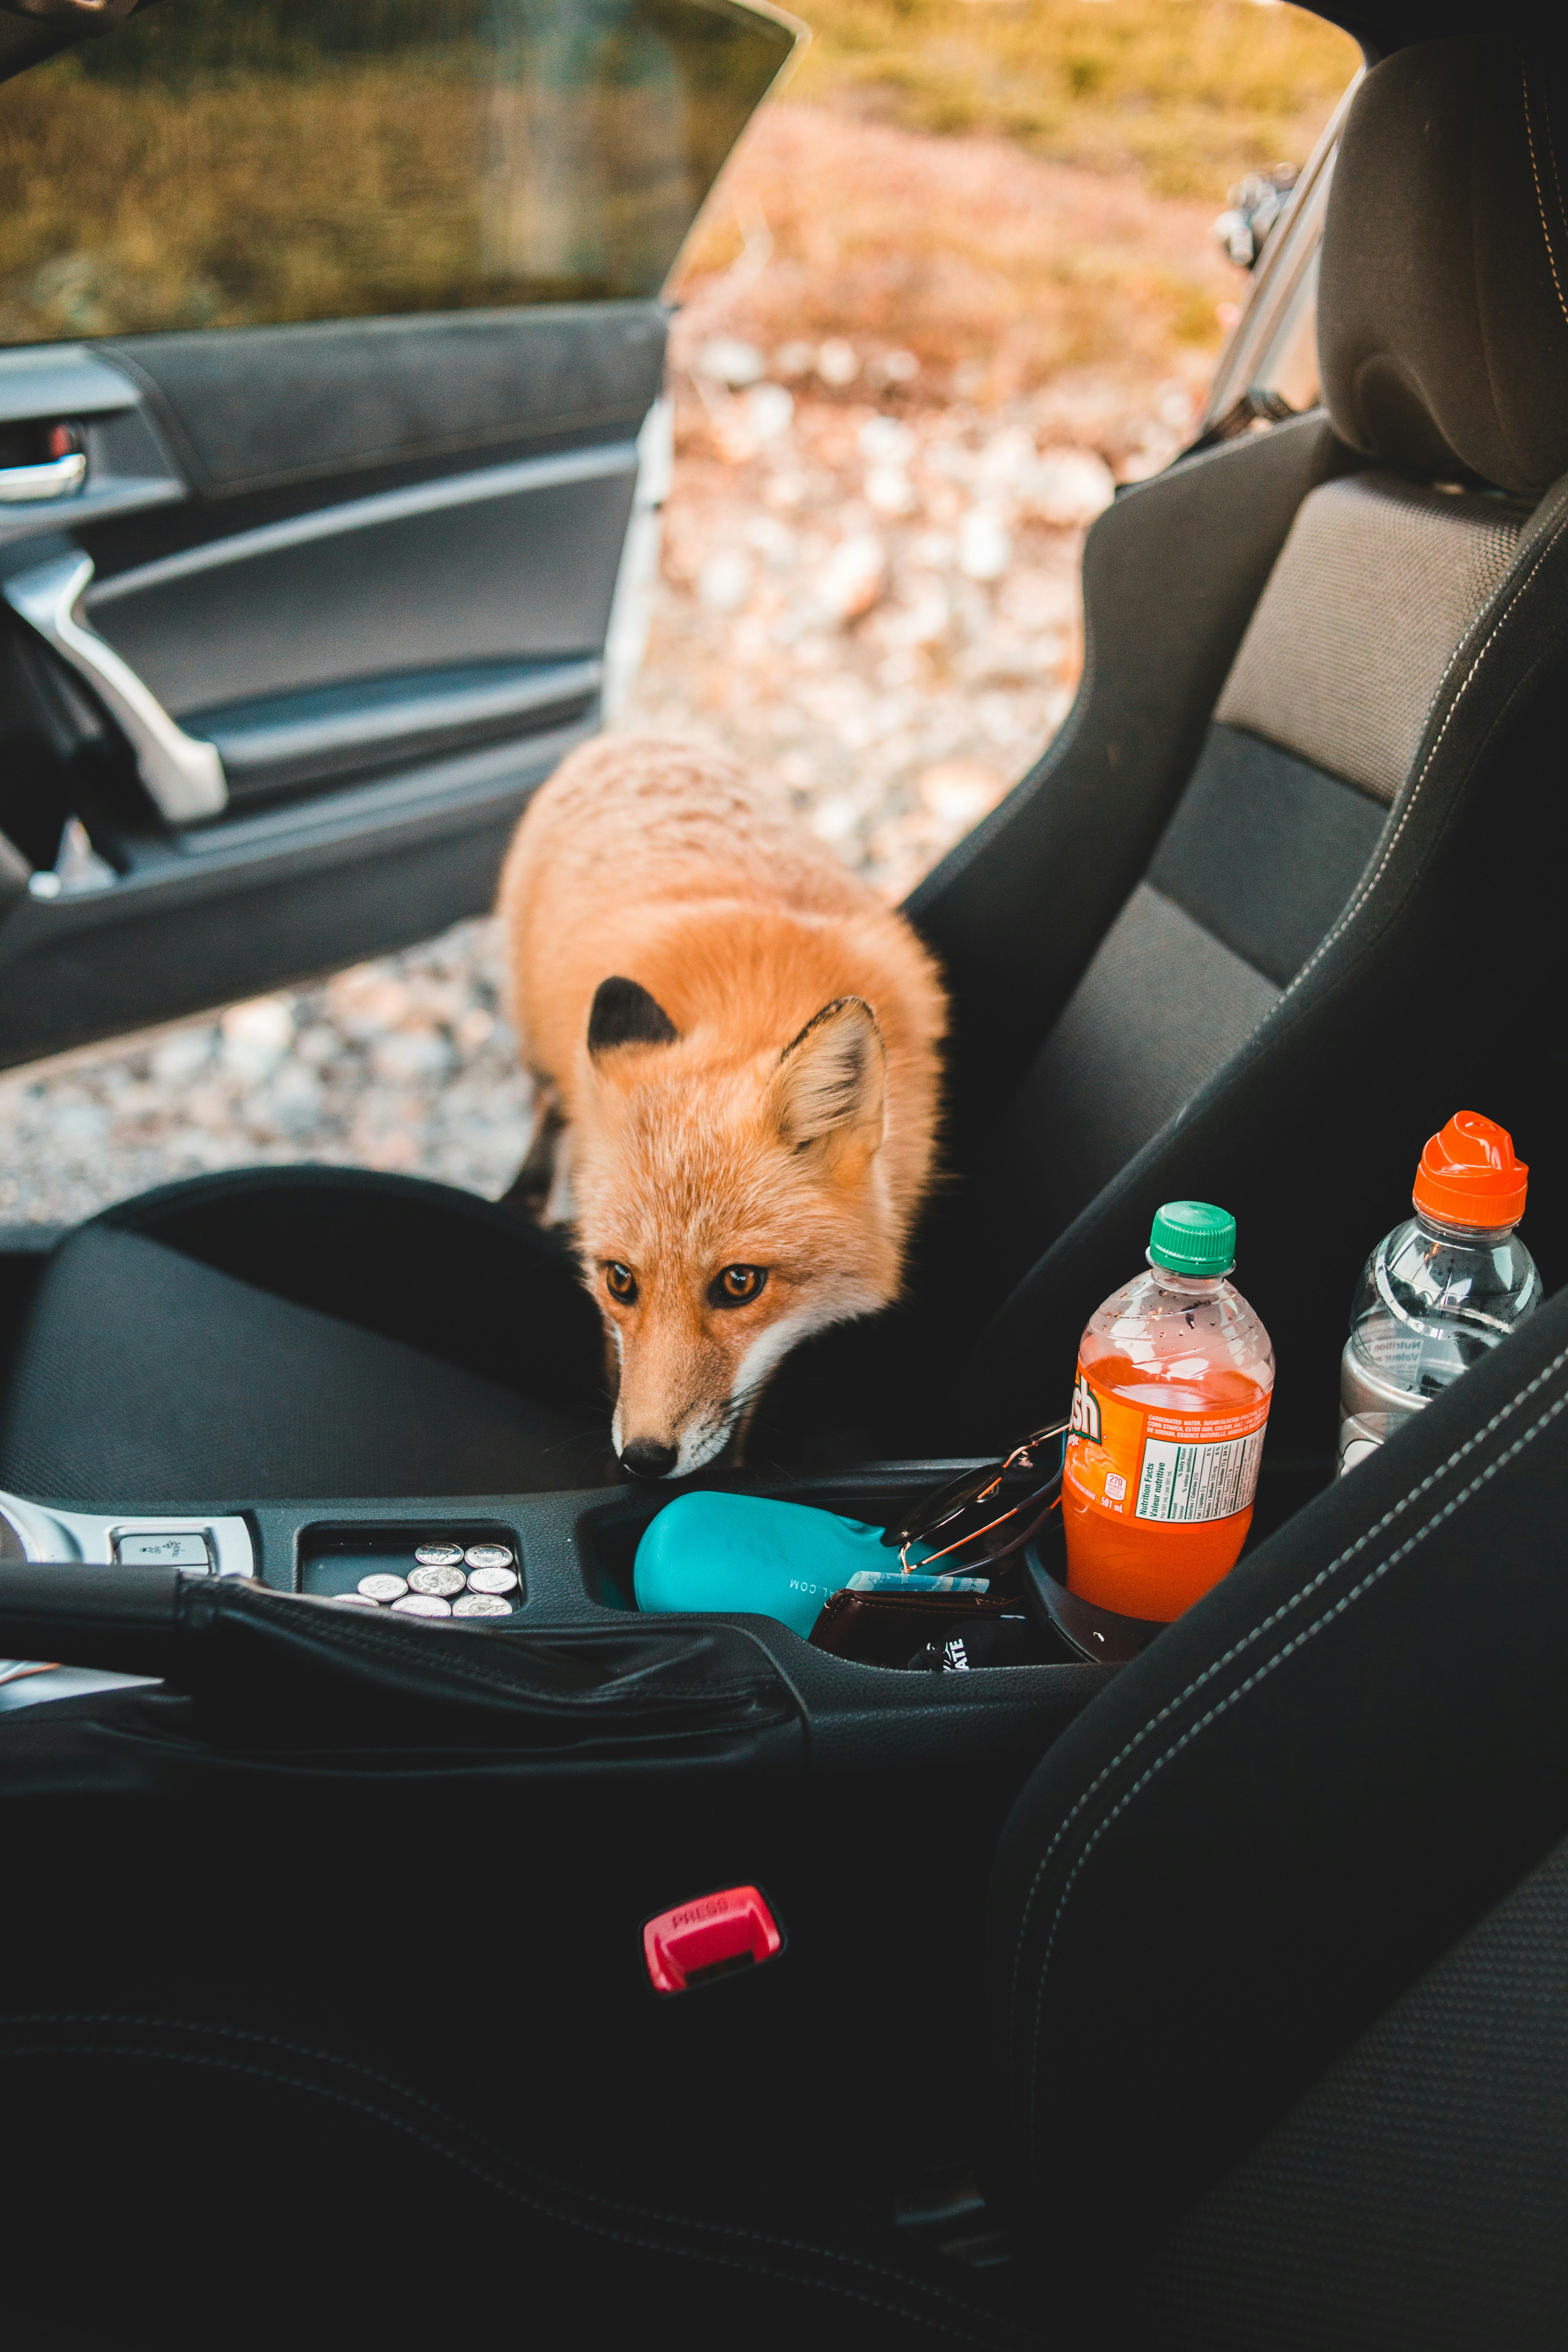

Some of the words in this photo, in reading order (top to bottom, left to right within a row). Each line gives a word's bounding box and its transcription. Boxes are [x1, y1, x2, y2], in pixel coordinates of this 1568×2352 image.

[1148, 1415, 1182, 1425] CARBONATED
[1163, 1424, 1184, 1432] STARCH,
[1155, 1428, 1176, 1438] SODIUM,
[1110, 1475, 1122, 1486] 270
[1144, 1463, 1154, 1482] Facts
[1150, 1494, 1159, 1516] Valeur
[1155, 1462, 1165, 1492] nutritive
[1101, 1496, 1112, 1509] 591
[1114, 1504, 1124, 1513] mL
[1139, 1484, 1151, 1515] Nutrition
[672, 1898, 728, 1929] PRESS
